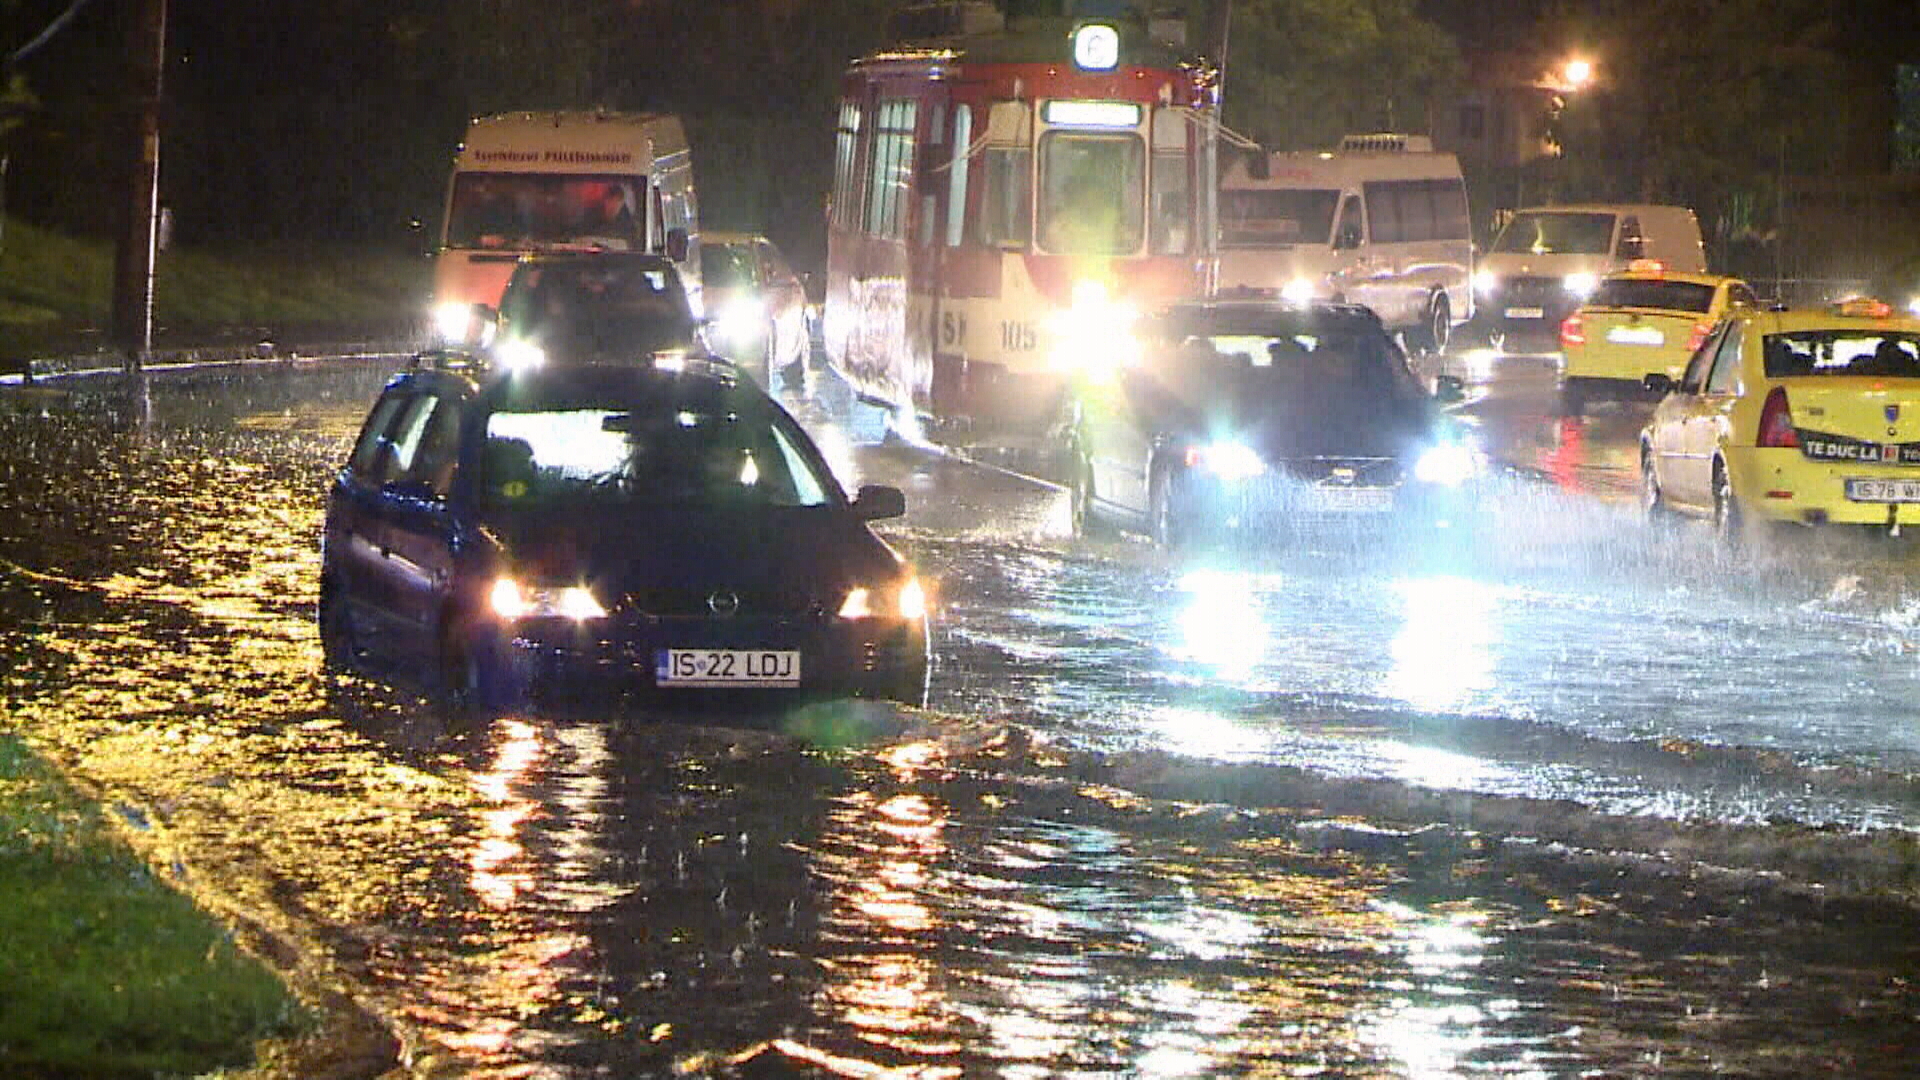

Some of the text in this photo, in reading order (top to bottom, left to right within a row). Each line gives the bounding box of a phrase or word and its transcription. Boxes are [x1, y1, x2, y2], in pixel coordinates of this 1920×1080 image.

[1807, 441, 1878, 460] TE DUC LA
[672, 653, 791, 676] IS 22 LDJ
